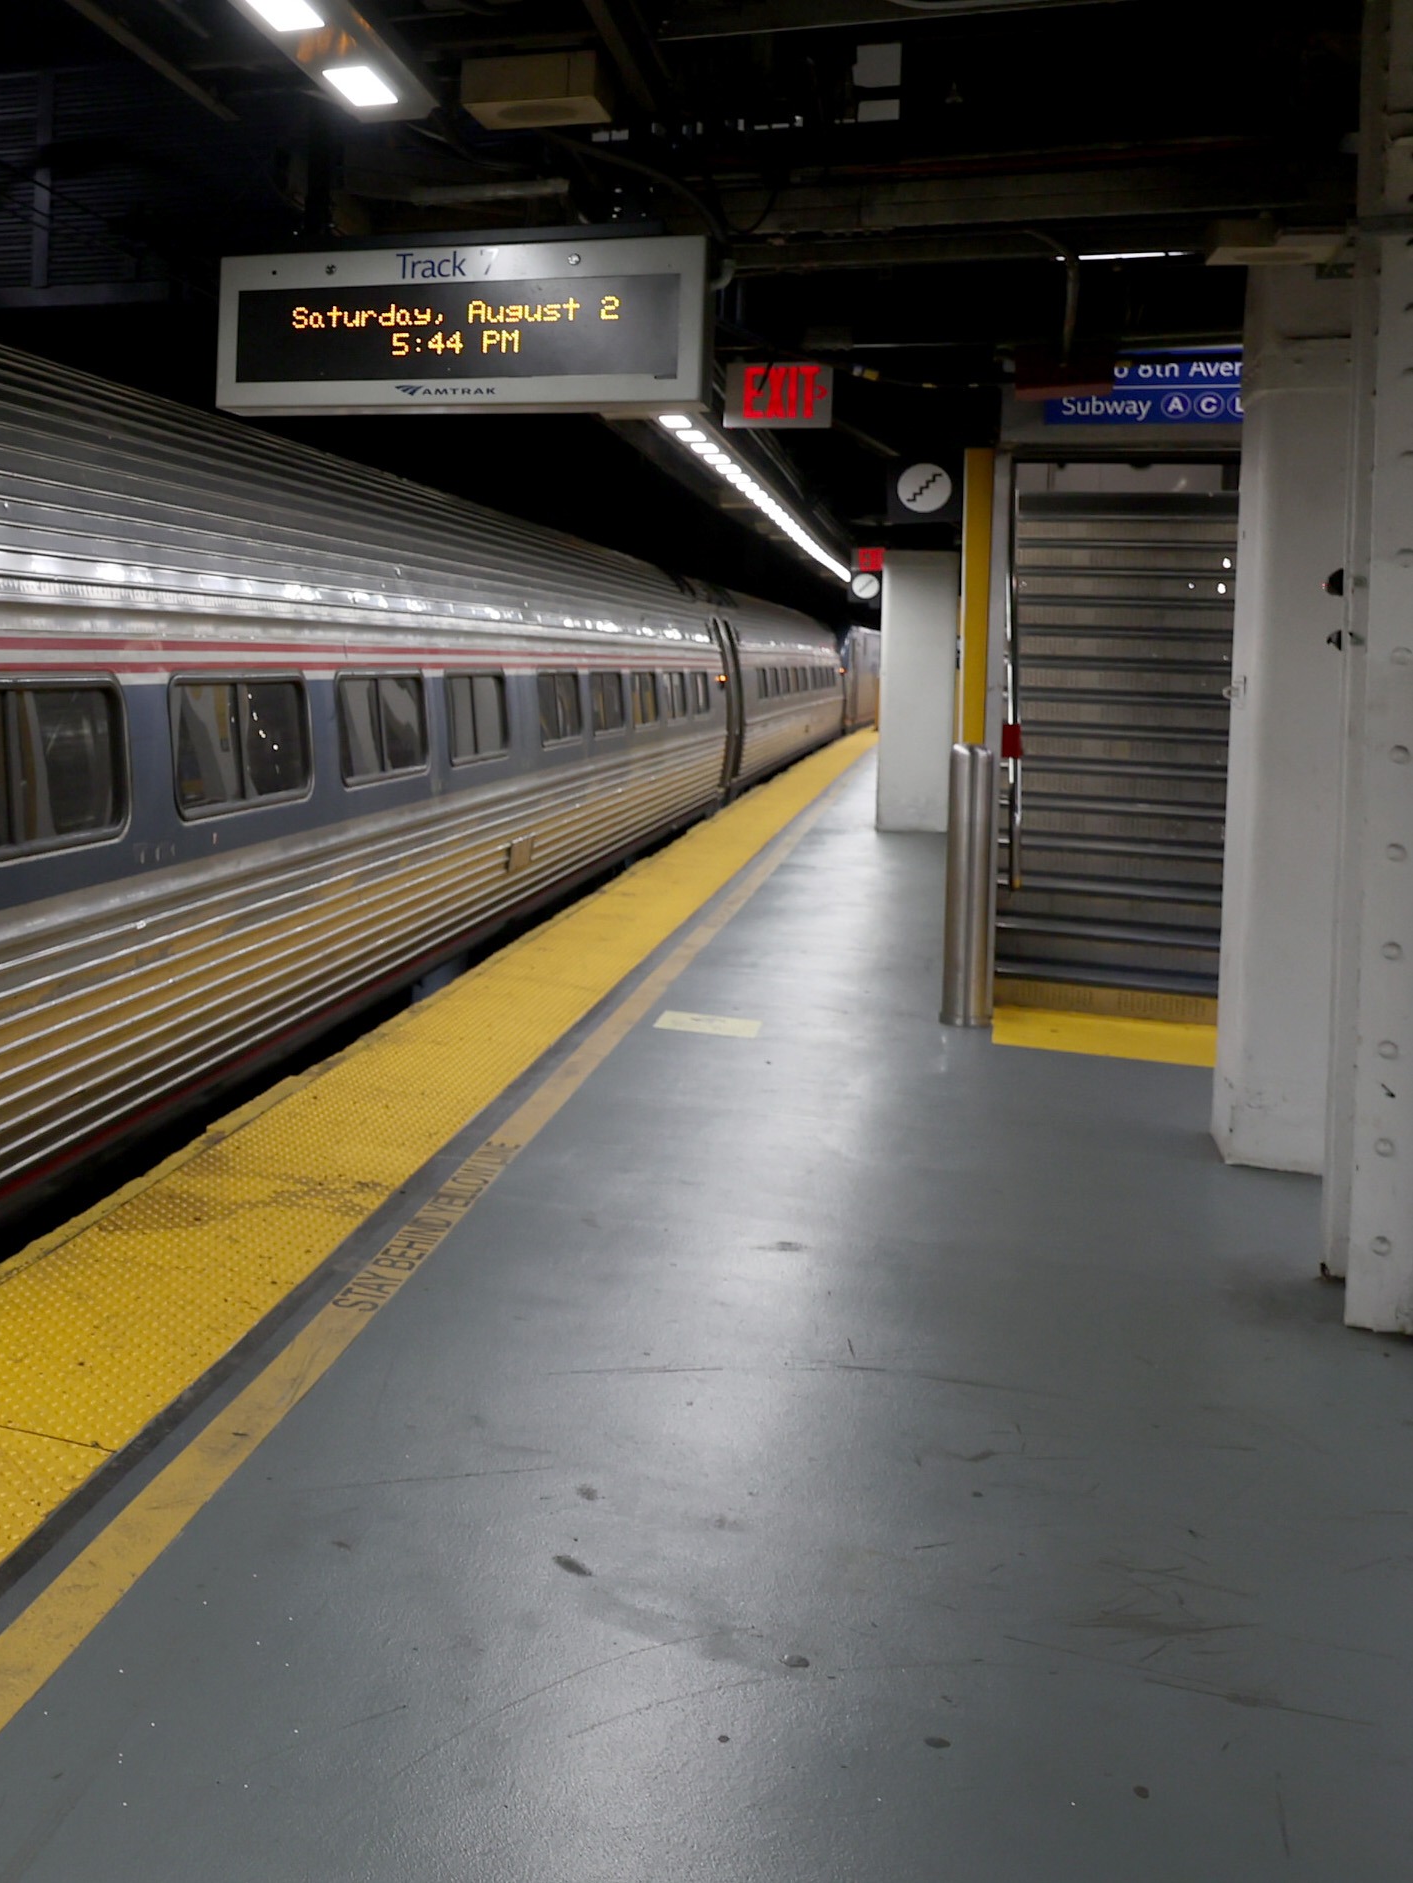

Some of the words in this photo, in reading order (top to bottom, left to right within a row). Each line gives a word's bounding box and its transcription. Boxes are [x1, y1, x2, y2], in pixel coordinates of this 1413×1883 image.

[395, 250, 467, 280] Track
[480, 247, 500, 276] 7
[292, 303, 444, 329] Saturday,
[467, 297, 580, 324] August
[600, 295, 620, 321] 2
[391, 330, 464, 356] 5:44
[481, 329, 521, 354] PM
[421, 386, 498, 397] AMTRAK
[742, 365, 822, 420] EXIT
[1061, 396, 1153, 422] Subway
[332, 1270, 403, 1313] STAY
[373, 1216, 452, 1272] BEHIND
